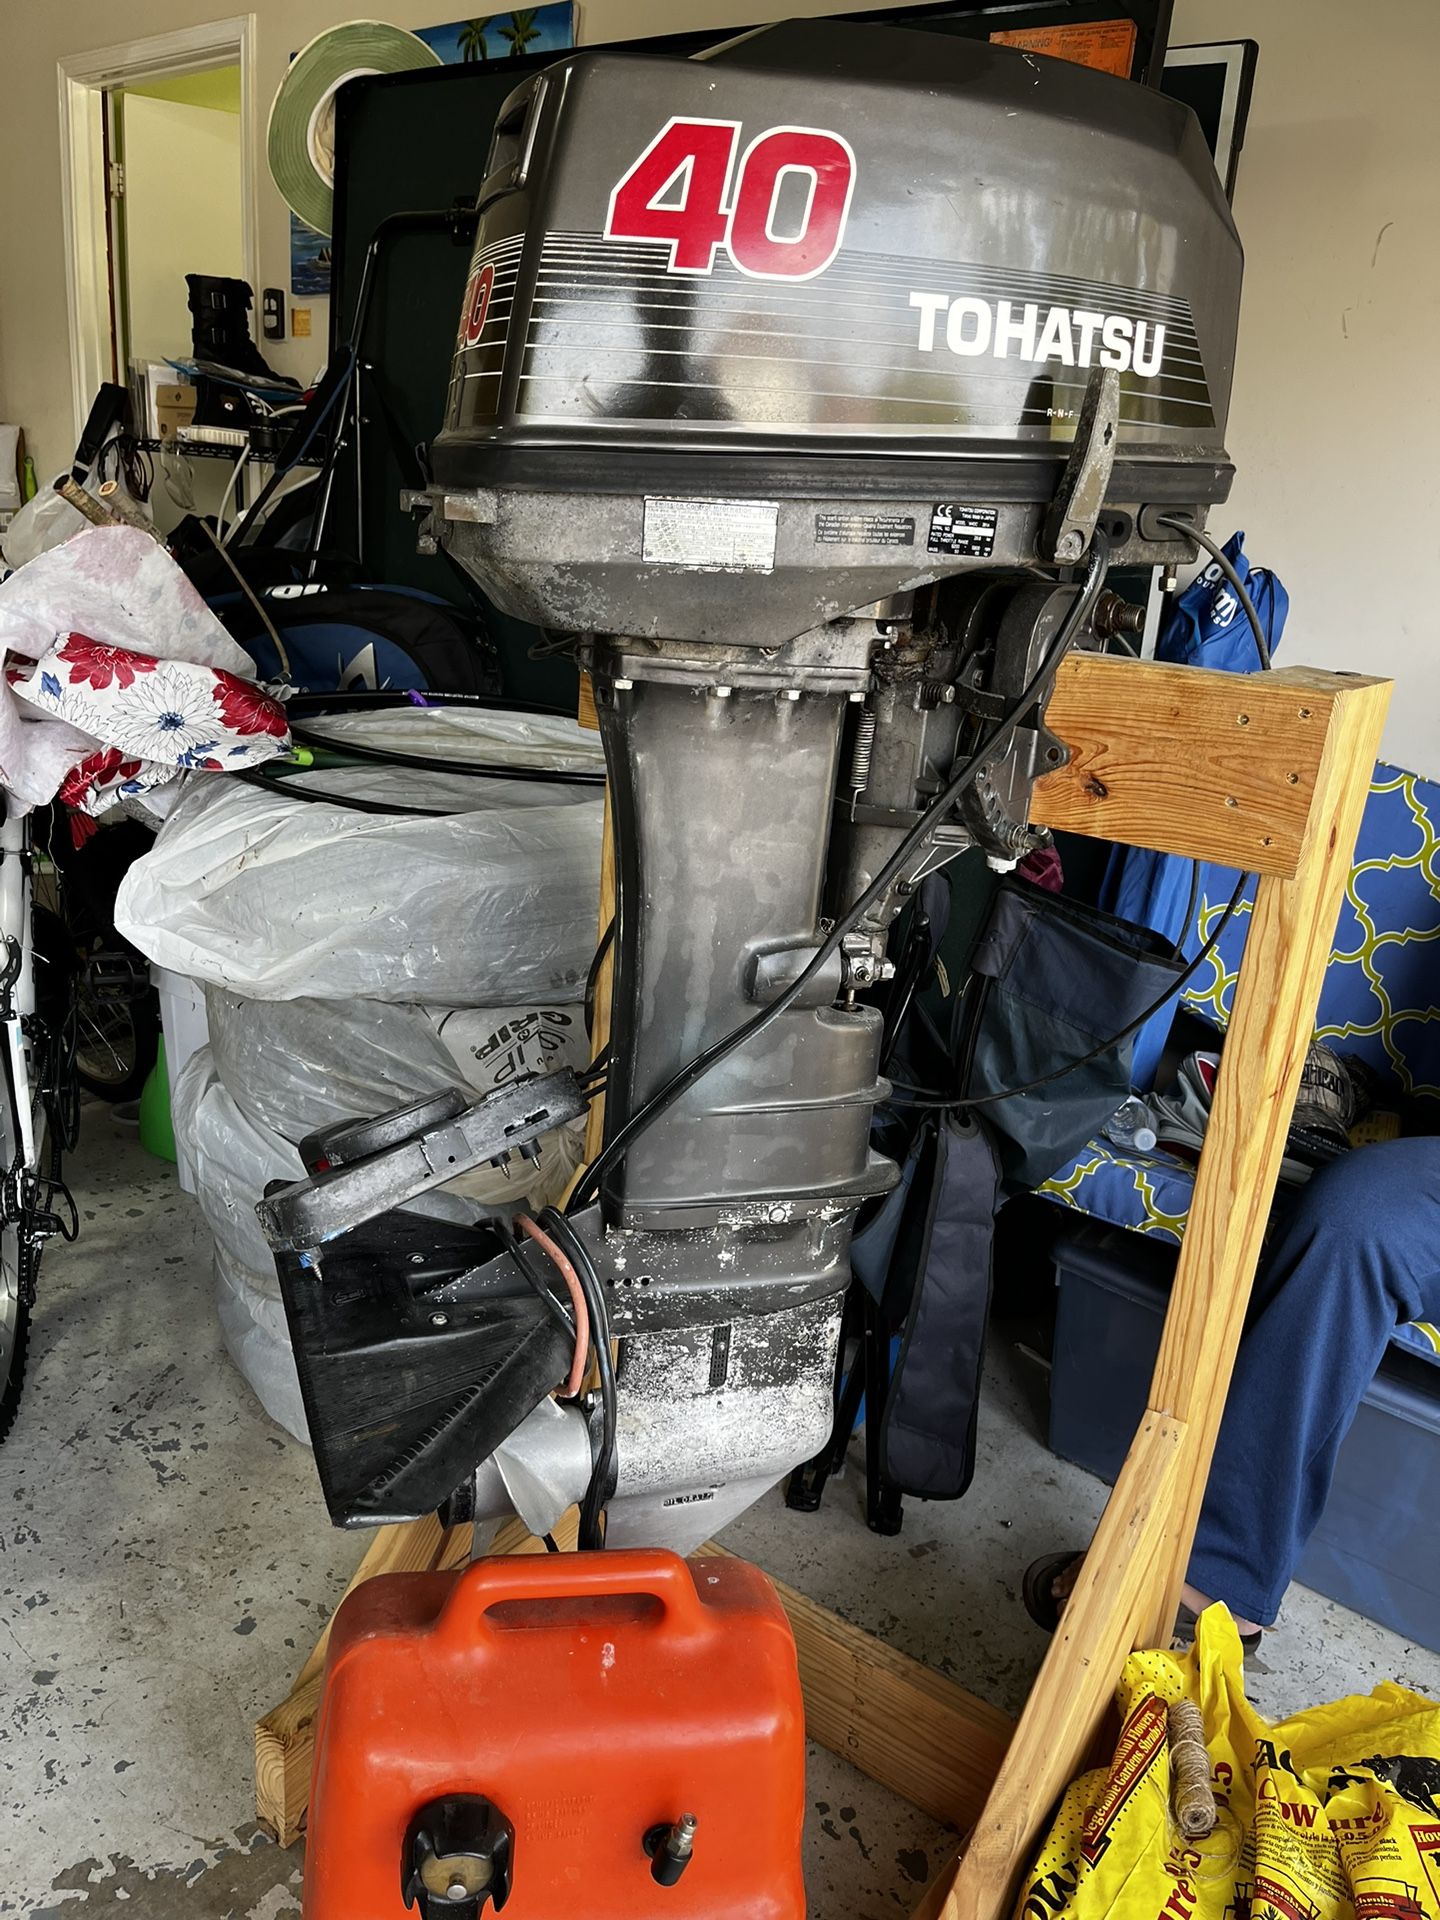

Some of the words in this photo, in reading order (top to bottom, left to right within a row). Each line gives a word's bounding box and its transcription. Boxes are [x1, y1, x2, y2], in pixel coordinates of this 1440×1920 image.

[603, 115, 857, 282] 40
[909, 291, 1166, 378] TOHATSU
[937, 504, 954, 518] CE
